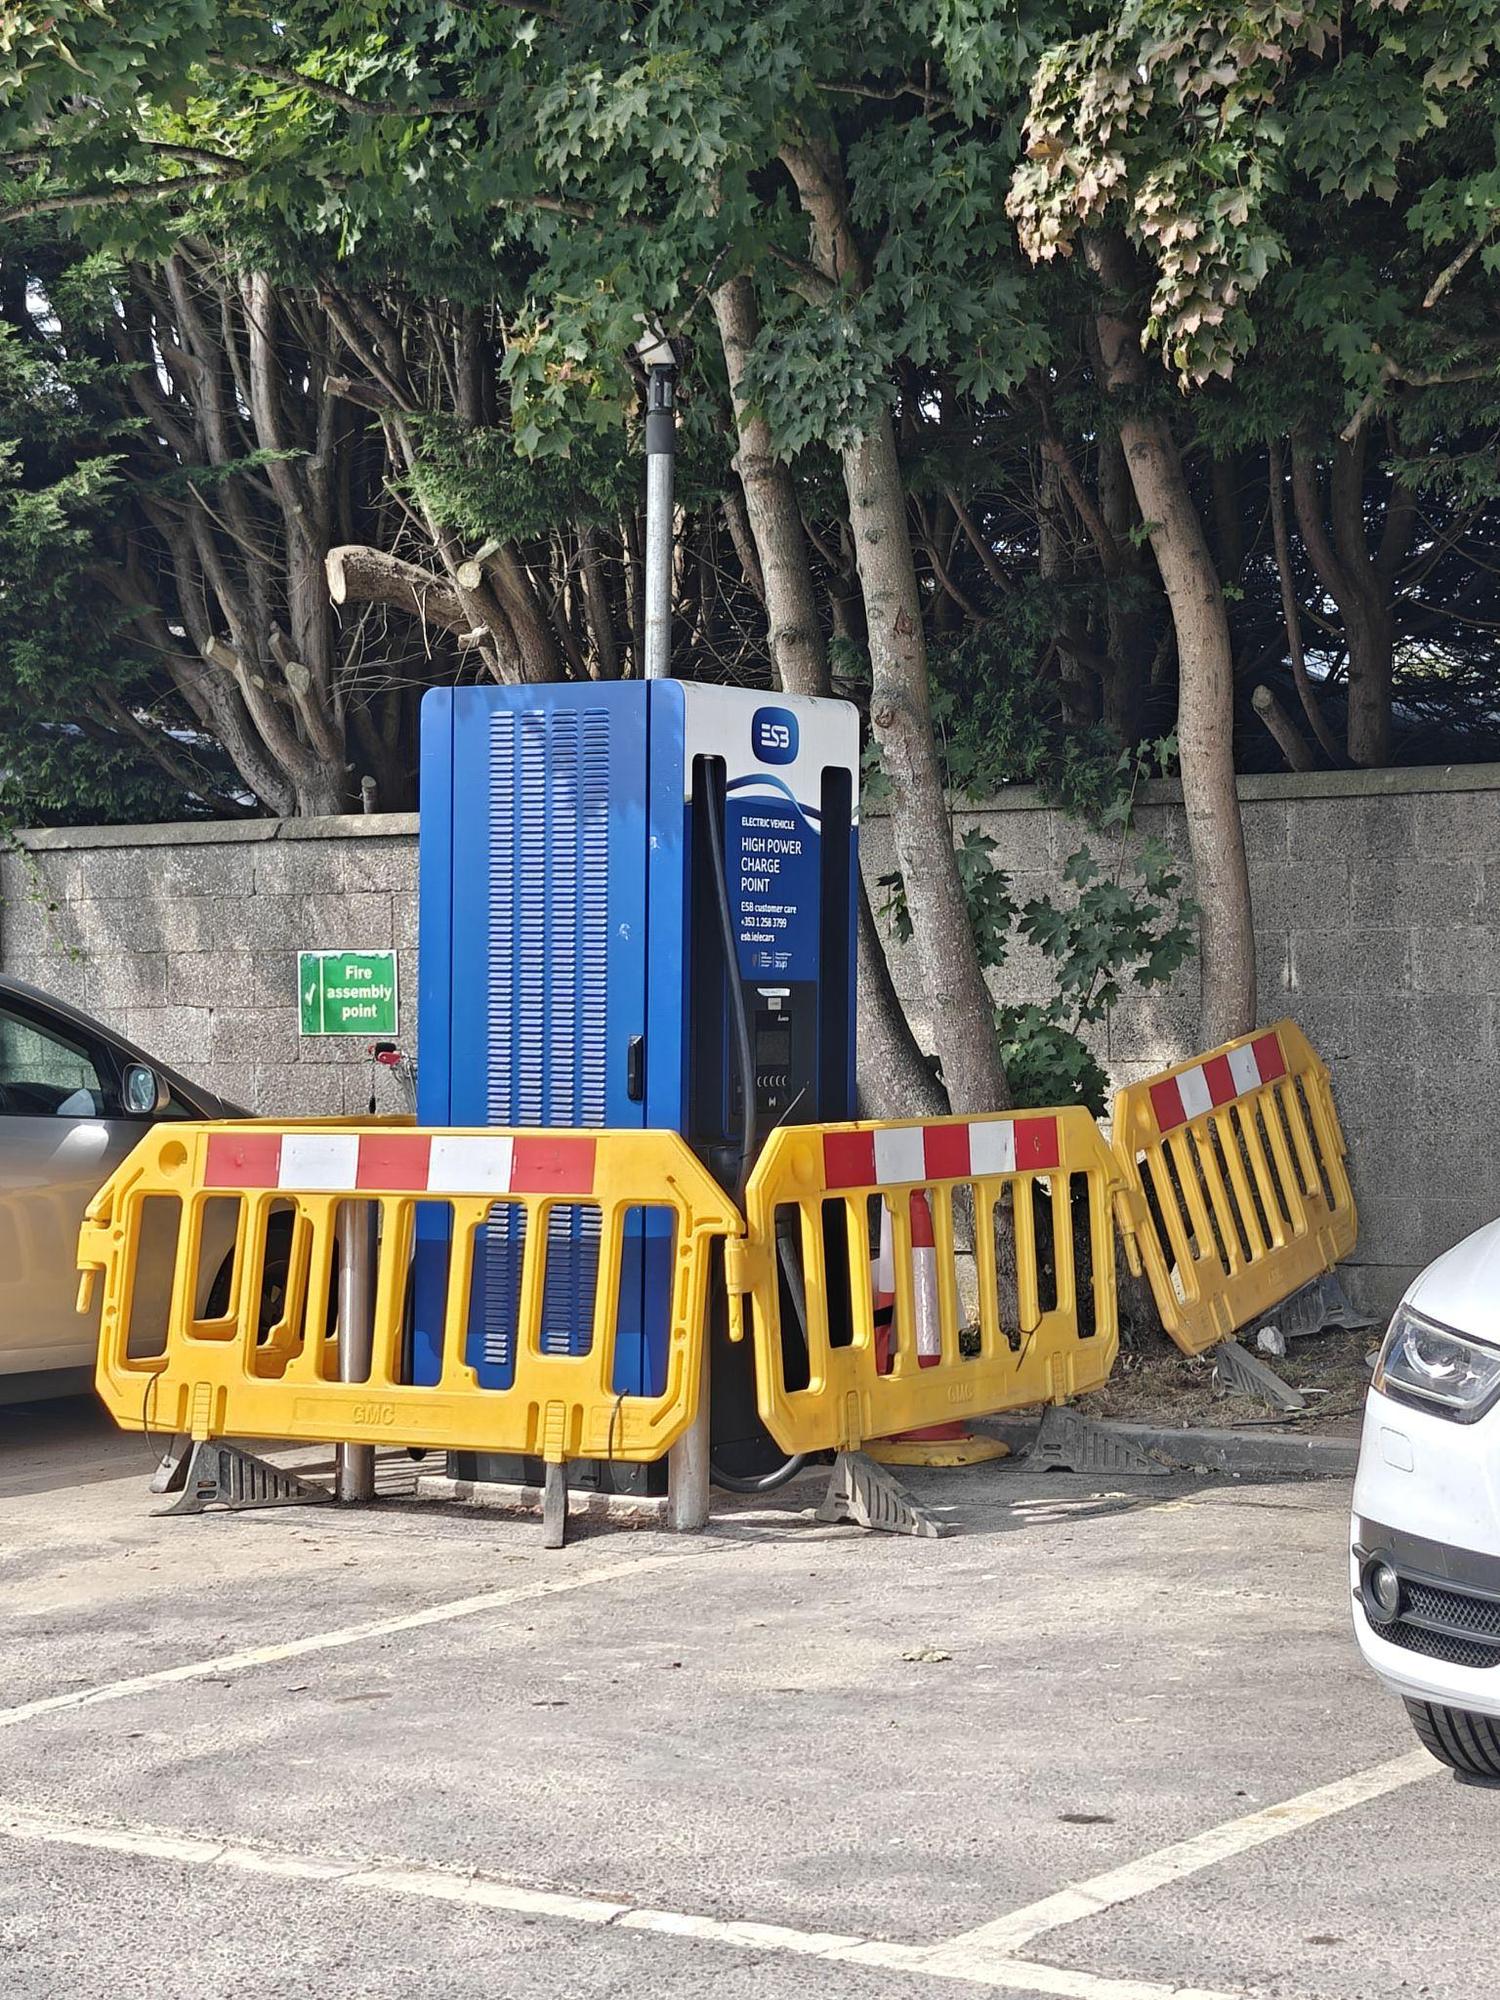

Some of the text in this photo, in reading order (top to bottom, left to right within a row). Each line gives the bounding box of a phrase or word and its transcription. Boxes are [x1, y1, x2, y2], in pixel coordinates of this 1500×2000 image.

[761, 723, 789, 748] ESB
[741, 816, 795, 830] ELECTRIC VEHICLE
[741, 836, 802, 855] HIGH POWER
[741, 857, 780, 873] CHARGE
[741, 877, 770, 892] POINT
[741, 901, 797, 914] ESB customer care
[345, 965, 373, 980] Fire
[327, 984, 392, 1002] assembly
[342, 1003, 378, 1021] point
[352, 1403, 396, 1425] GMC
